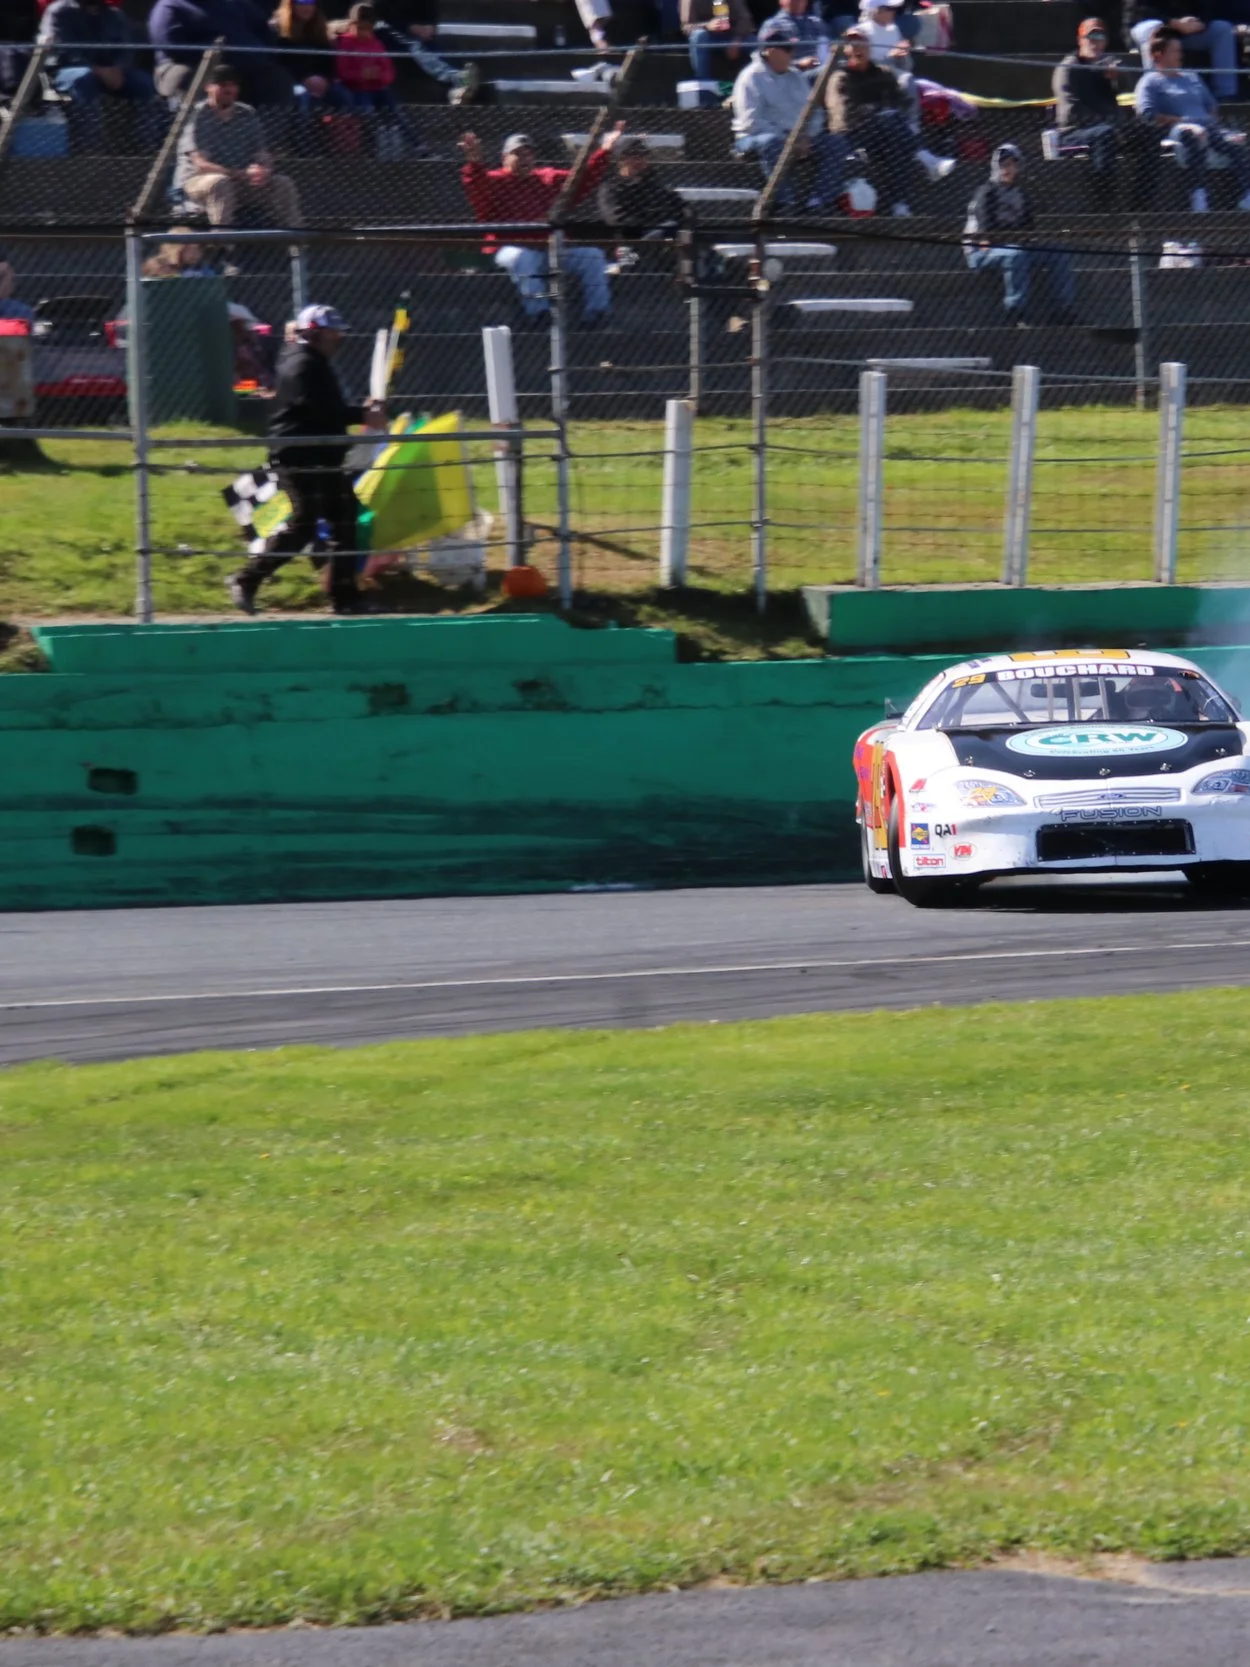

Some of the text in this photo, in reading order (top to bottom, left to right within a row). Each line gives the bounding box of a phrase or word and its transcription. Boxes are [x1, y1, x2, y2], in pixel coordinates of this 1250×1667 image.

[952, 664, 1154, 688] 29 BOUCHARD
[1038, 732, 1156, 745] CRW
[1060, 806, 1162, 822] FUSION
[935, 823, 957, 838] QA1
[916, 855, 943, 868] tilton
